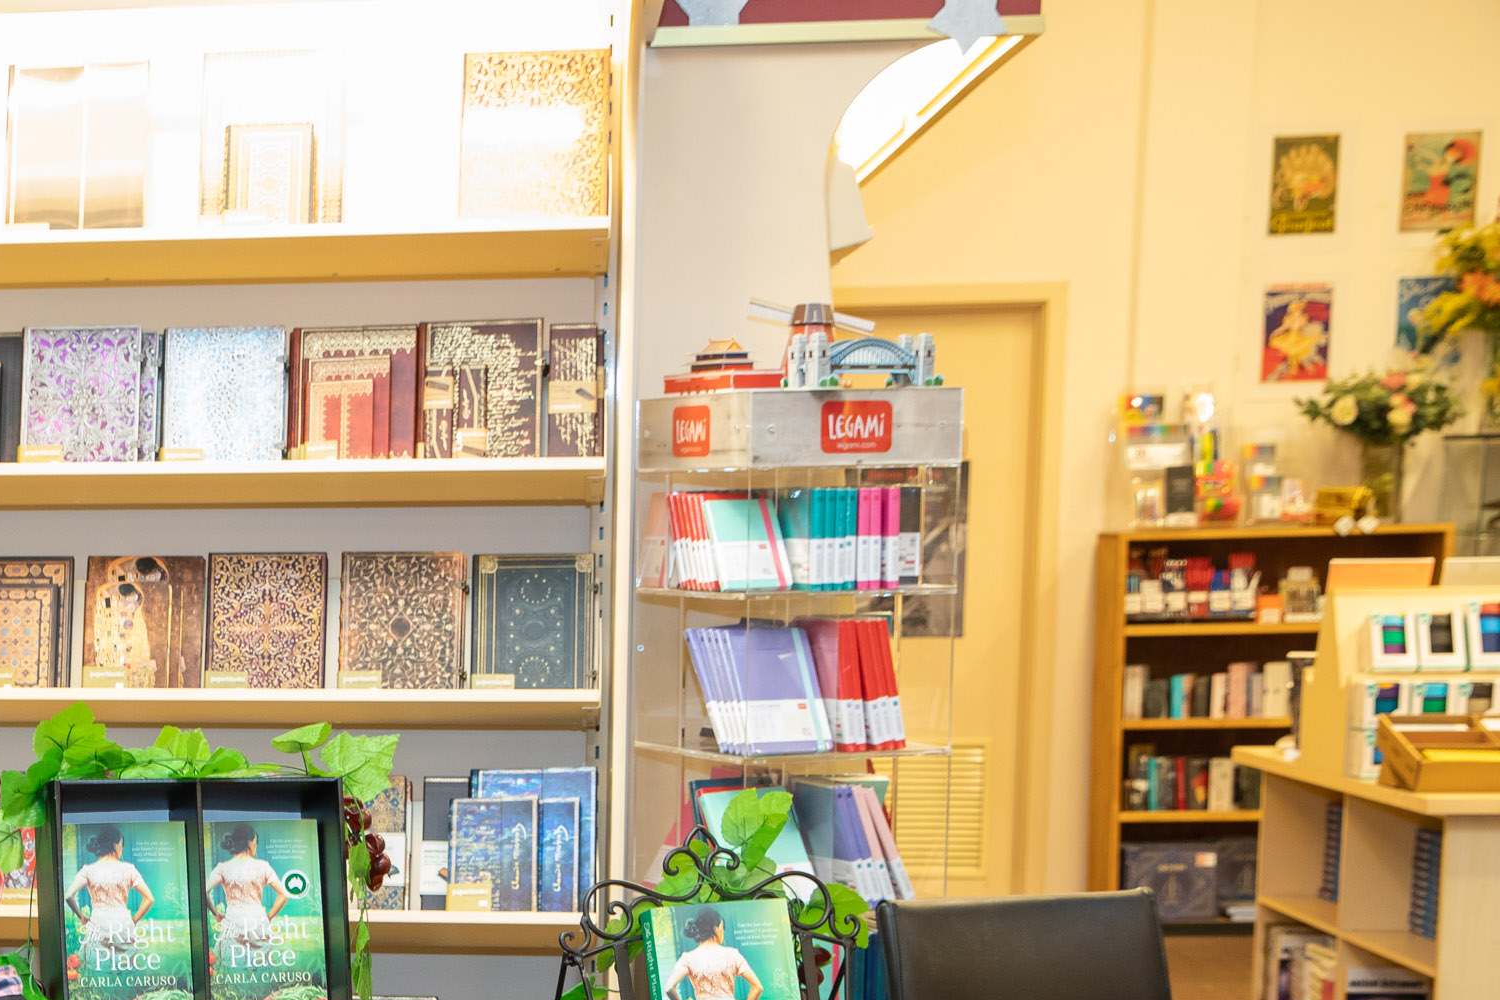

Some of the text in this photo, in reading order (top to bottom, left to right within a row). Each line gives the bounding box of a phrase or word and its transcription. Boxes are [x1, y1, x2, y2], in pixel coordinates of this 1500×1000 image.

[107, 917, 175, 949] Right
[243, 914, 310, 946] Right
[95, 946, 161, 971] Place
[230, 942, 296, 968] Place
[81, 975, 176, 988] CARLA CARUSO
[216, 971, 311, 984] CARLA CARUSO
